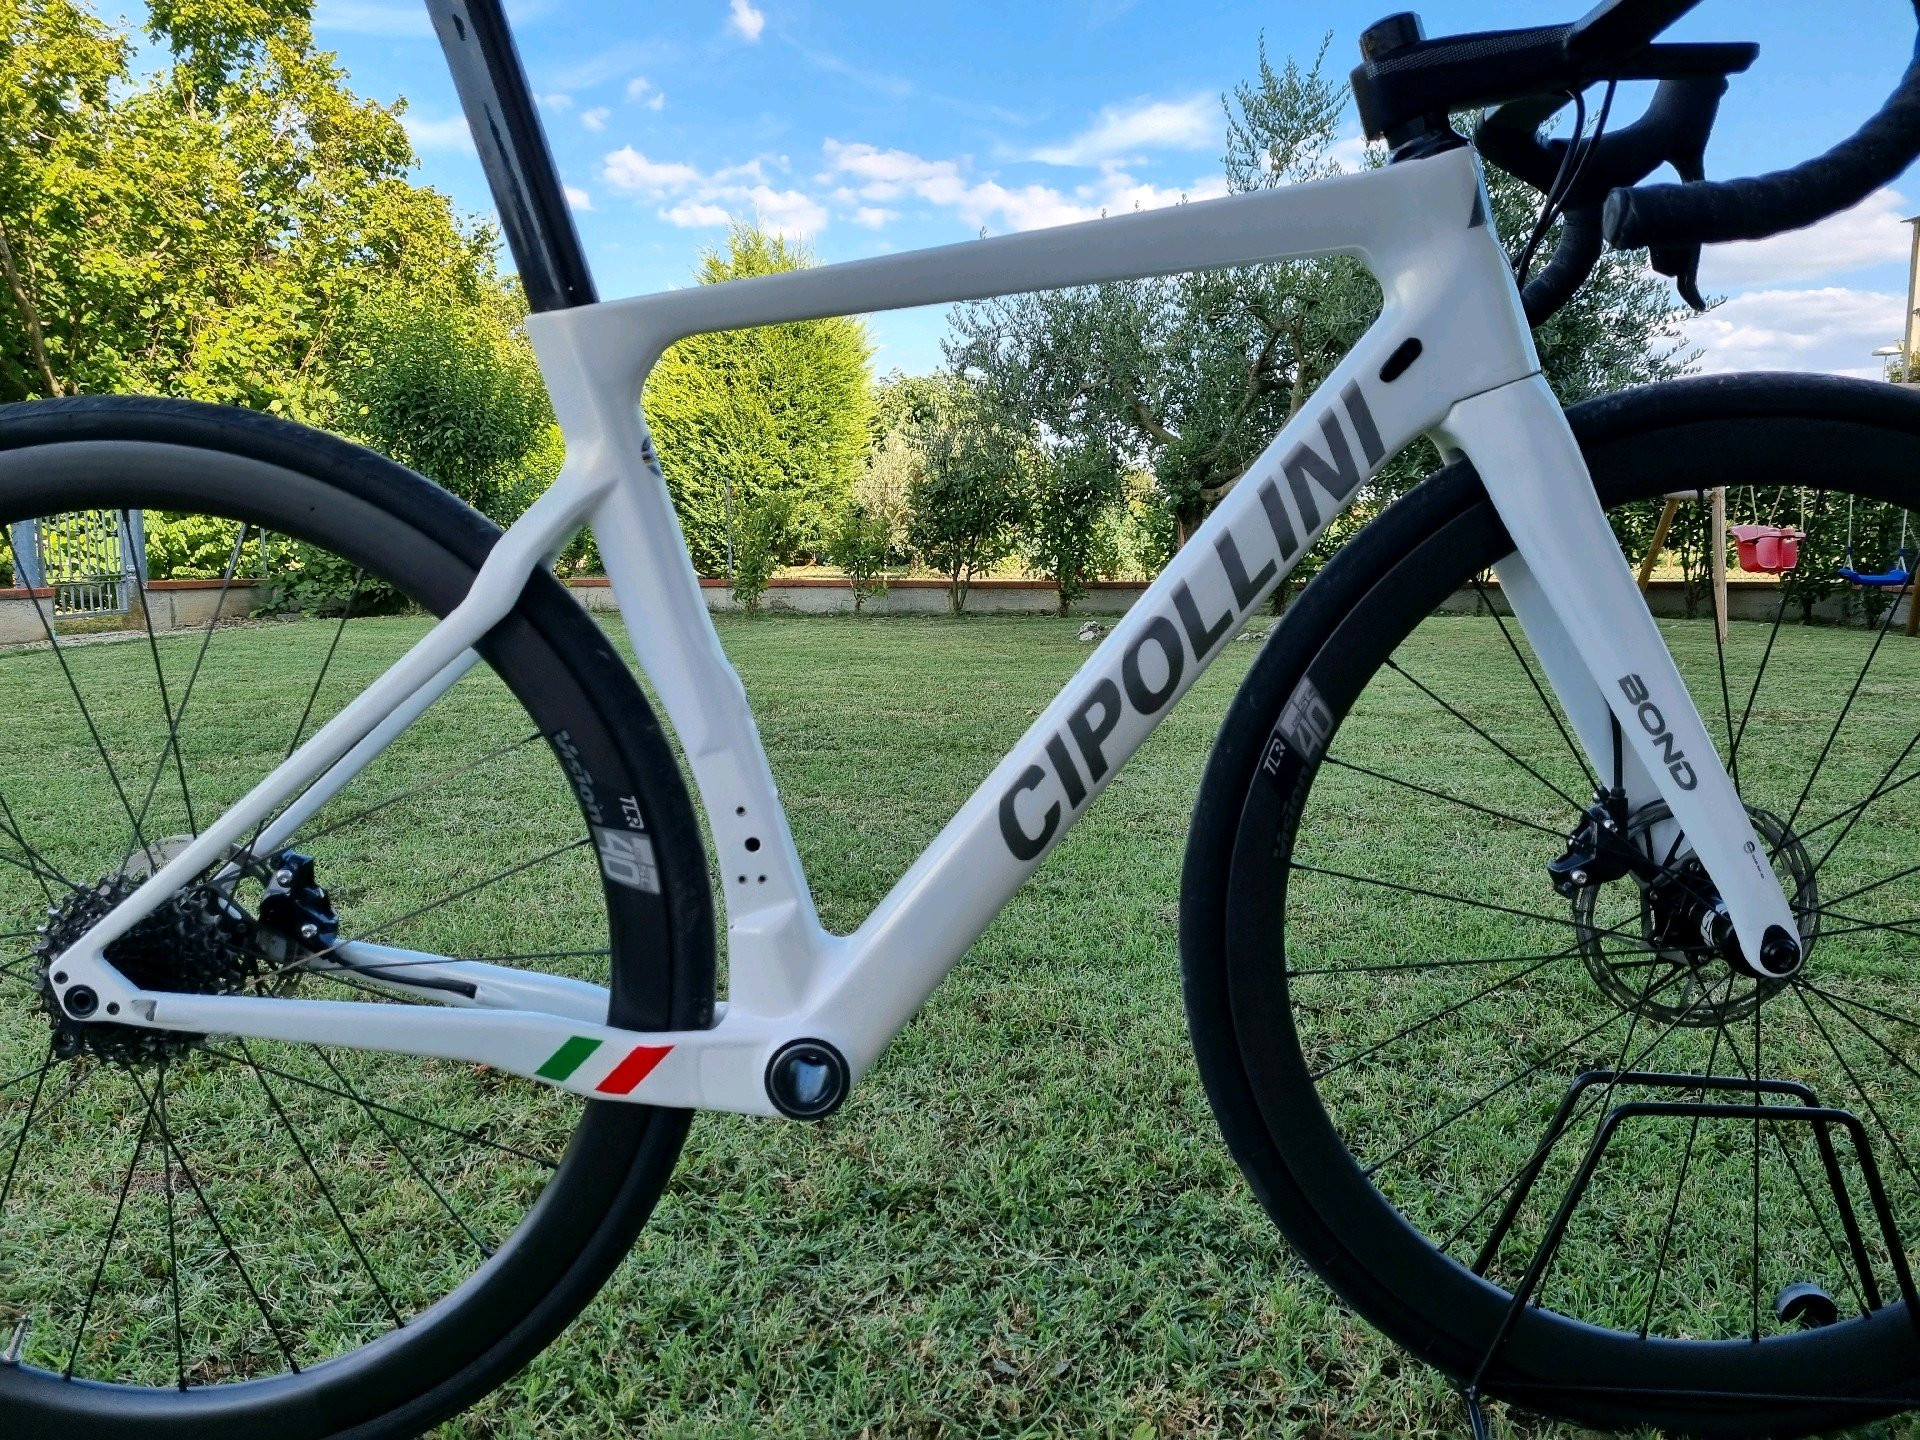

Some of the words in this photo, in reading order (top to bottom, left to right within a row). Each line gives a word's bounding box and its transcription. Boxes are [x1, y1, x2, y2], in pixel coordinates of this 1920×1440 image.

[1000, 380, 1386, 860] CIPOLLINI
[1263, 738, 1286, 775] TLR
[1618, 673, 1698, 791] BOND
[619, 795, 645, 829] TLR
